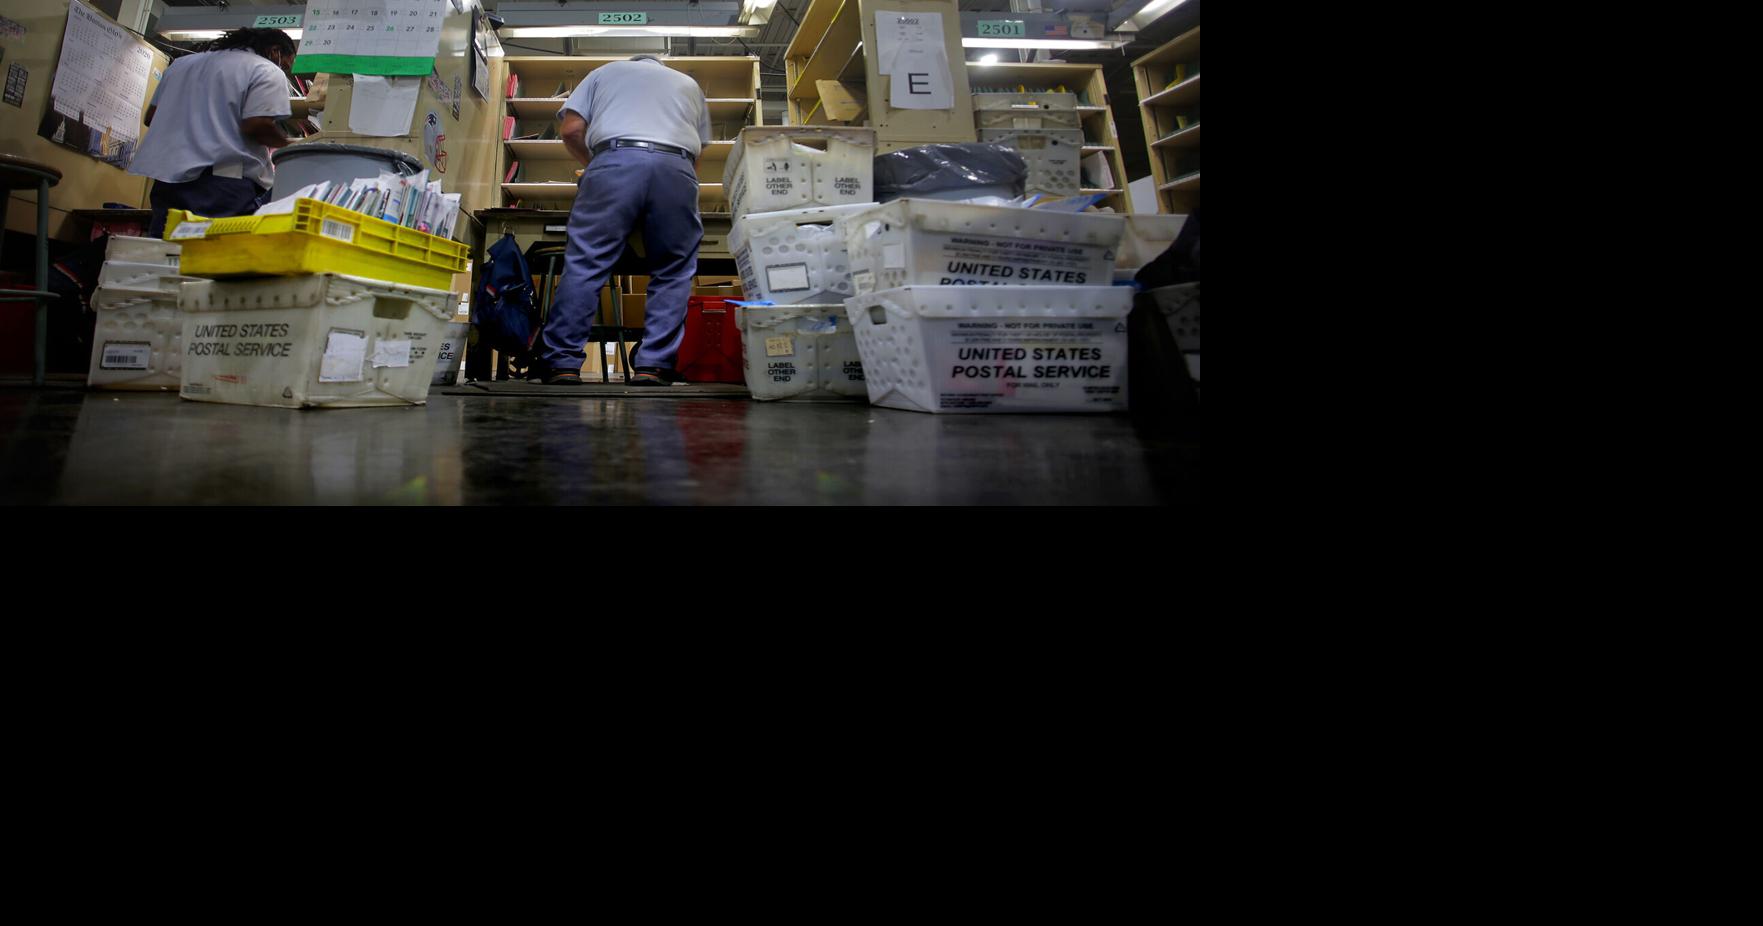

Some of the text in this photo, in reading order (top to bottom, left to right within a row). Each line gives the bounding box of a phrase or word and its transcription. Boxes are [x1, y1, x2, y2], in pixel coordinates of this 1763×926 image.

[258, 16, 297, 25] 2503
[602, 13, 642, 22] 2502
[982, 24, 1021, 35] 2501
[908, 73, 931, 94] E
[947, 261, 1087, 284] UNITED STATES
[940, 277, 1007, 285] POST
[195, 323, 290, 338] UNITED STATES
[187, 342, 292, 357] POSTAL SERVICE
[958, 348, 1102, 361] UNITED STATES
[951, 365, 1111, 378] POSTAL SERVICE
